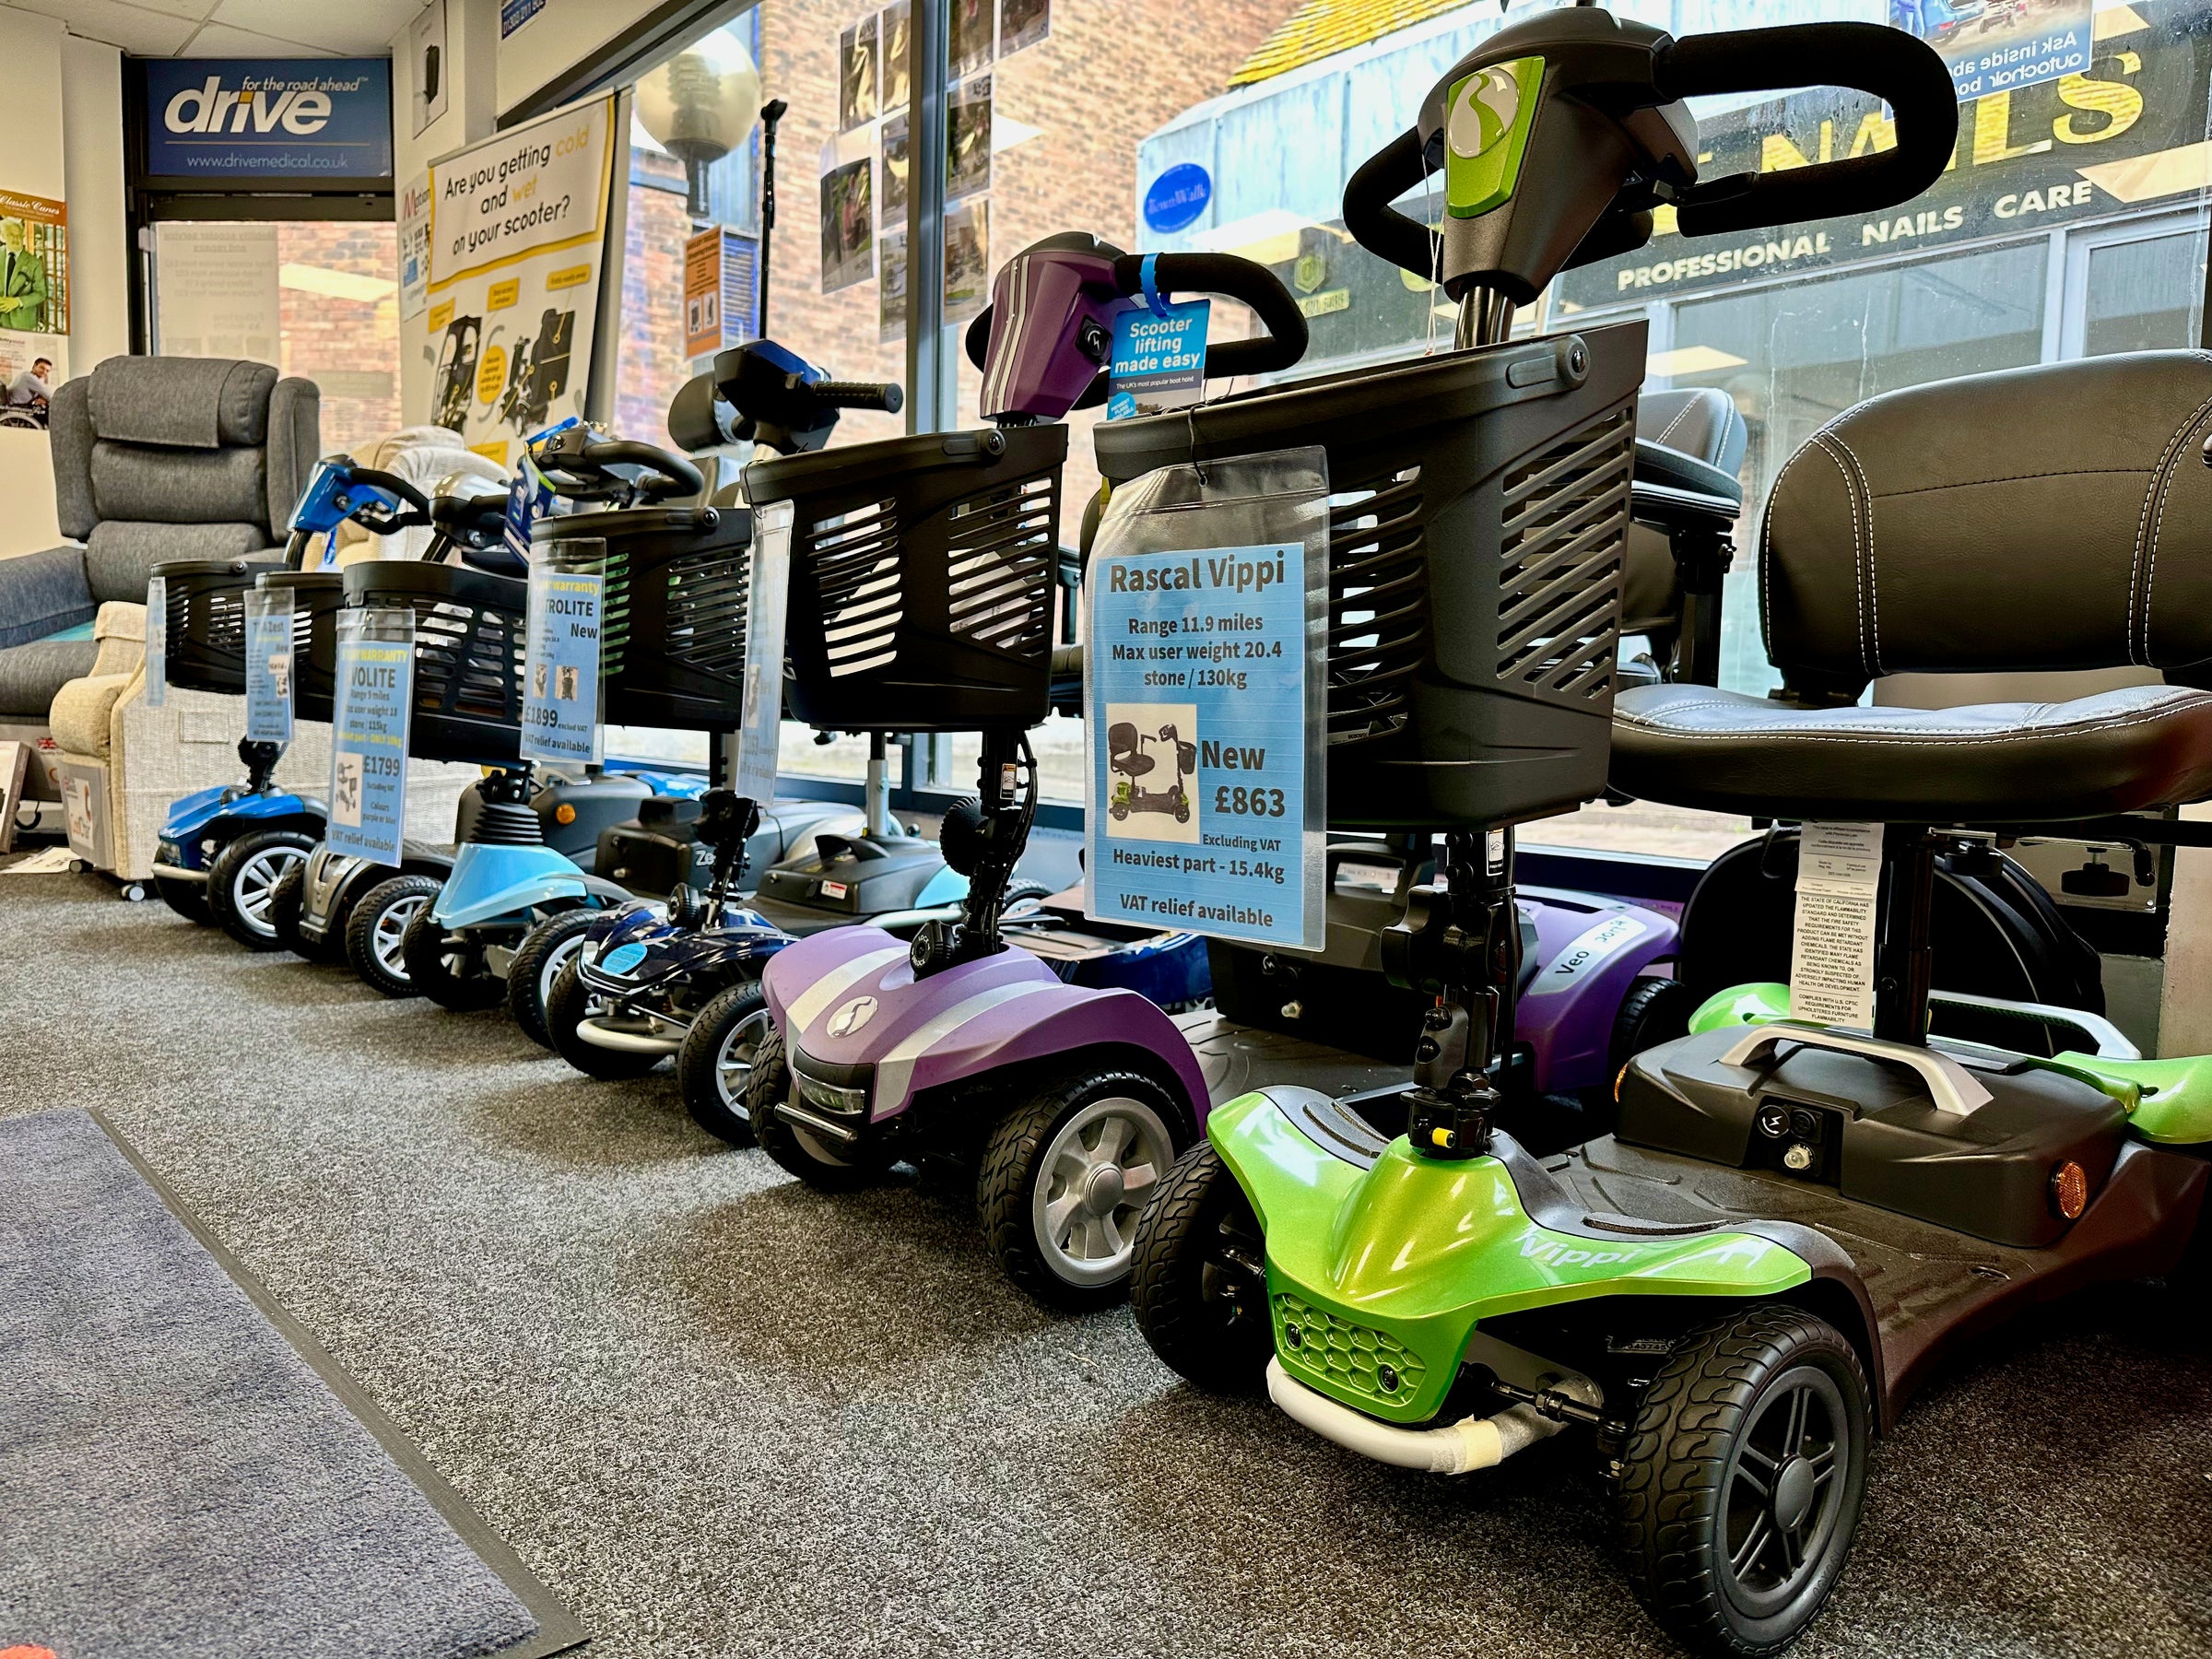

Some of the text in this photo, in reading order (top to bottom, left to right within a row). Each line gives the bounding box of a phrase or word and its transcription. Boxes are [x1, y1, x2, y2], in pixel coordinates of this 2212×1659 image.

[242, 76, 261, 91] for
[263, 76, 285, 90] the
[287, 77, 319, 90] road
[164, 76, 332, 135] drive
[187, 152, 348, 169] www.drivemedical.co.uk
[445, 124, 590, 200] Are you getting cold
[480, 183, 508, 215] and
[453, 194, 571, 256] on your scooter?
[1618, 181, 2093, 291] PROFESSIONAL NAILS CARE
[1130, 318, 1193, 338] Scooter
[1135, 336, 1182, 354] lifting
[1114, 352, 1200, 373] made easy
[1150, 379, 1169, 388] popular
[1111, 550, 1284, 593] Rascal Vippi
[553, 580, 600, 597] warranty
[570, 623, 598, 640] New
[1128, 613, 1264, 638] Range 11.9 miles
[360, 649, 408, 663] WARRANTY
[1112, 641, 1282, 664] Max user weight 20.4
[1145, 668, 1247, 690] stone / 130kg
[524, 705, 559, 728] £1899
[577, 724, 588, 733] VAT
[551, 739, 590, 753] available
[1202, 740, 1265, 771] New
[363, 755, 400, 777] £1799
[1215, 785, 1286, 818] £863
[332, 830, 395, 853] VAT relief available
[1203, 833, 1281, 853] Excluding VAT
[695, 850, 716, 866] Ze
[1113, 849, 1180, 869] Heaviest
[1183, 857, 1216, 874] part
[1229, 859, 1285, 885] 15.4kg
[1120, 893, 1273, 927] VAT relief available
[1555, 950, 1590, 976] Veo
[1798, 1006, 1830, 1015] UPHOLSTERED
[1806, 1001, 1841, 1010] REQUIREMENTS
[1812, 1014, 1844, 1022] FLAMMABILITY
[1520, 1237, 1642, 1268] Vippi
